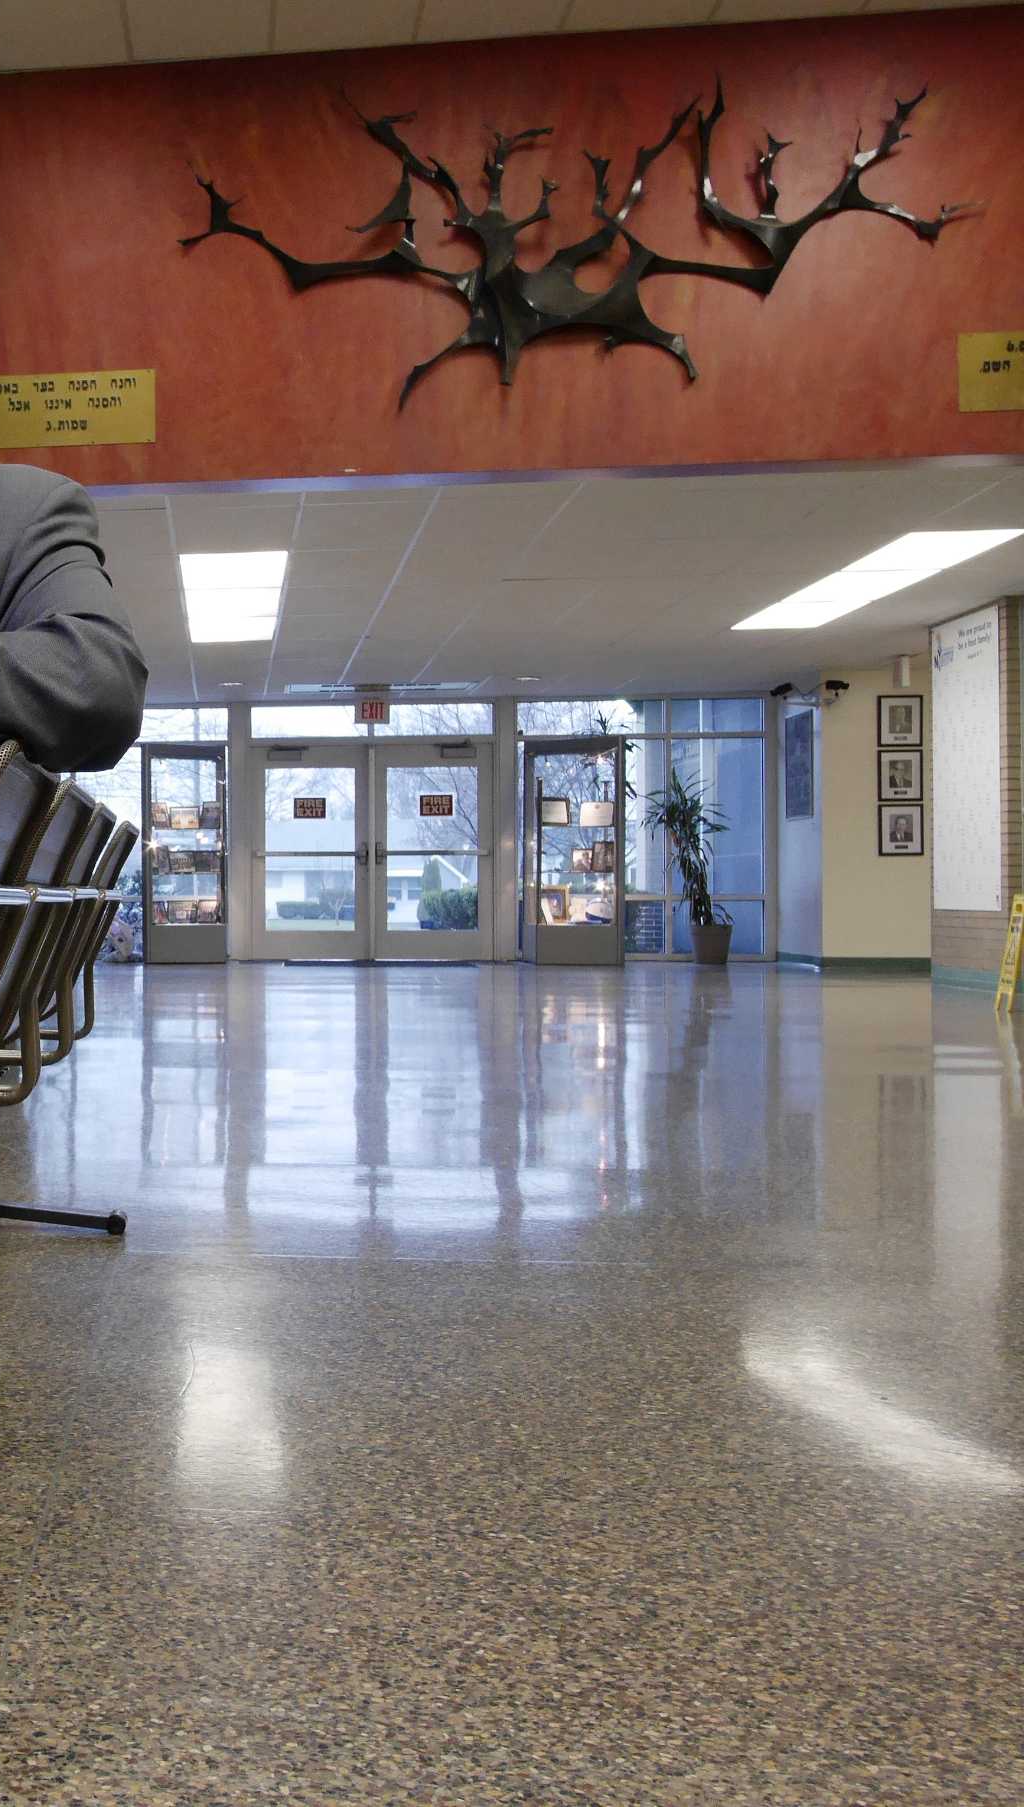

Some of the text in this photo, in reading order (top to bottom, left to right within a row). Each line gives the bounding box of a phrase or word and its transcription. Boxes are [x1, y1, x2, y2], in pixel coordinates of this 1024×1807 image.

[361, 702, 385, 720] EXIT
[296, 799, 324, 808] FIRE
[422, 796, 450, 806] FIRE
[296, 807, 325, 817] EXIT
[422, 805, 451, 814] EXIT
